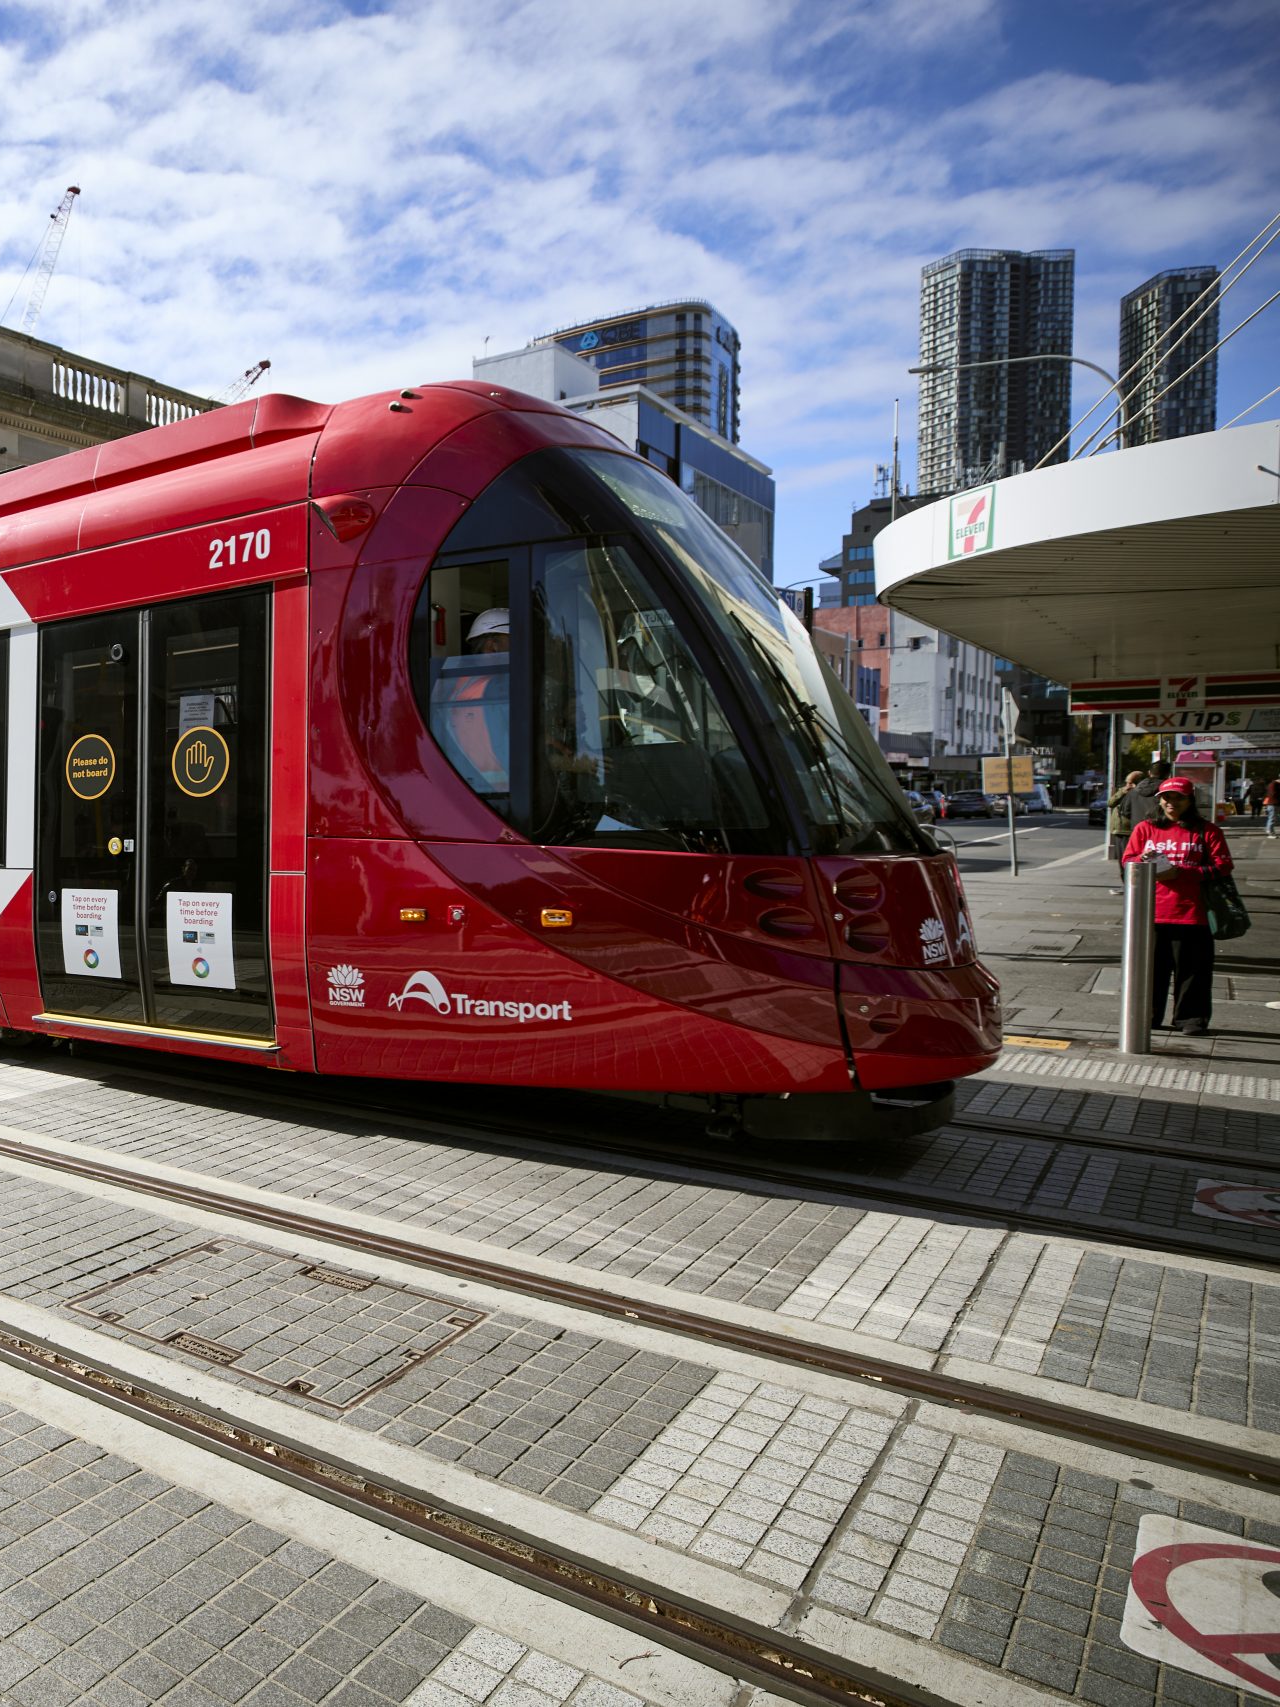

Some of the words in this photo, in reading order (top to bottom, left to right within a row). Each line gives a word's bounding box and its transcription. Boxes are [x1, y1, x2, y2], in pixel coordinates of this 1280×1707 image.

[209, 528, 271, 570] 2170
[73, 758, 97, 767] Please
[98, 756, 108, 765] do
[72, 769, 85, 778] not
[86, 768, 108, 777] board
[1144, 839, 1177, 853] Ask
[1181, 841, 1203, 852] me
[72, 895, 82, 903] Tap
[177, 899, 190, 907] Tap
[76, 912, 102, 920] boarding
[195, 909, 218, 917] before
[184, 917, 214, 926] boarding
[922, 940, 946, 960] NSW
[328, 987, 365, 1002] NSW
[450, 993, 573, 1023] Transport
